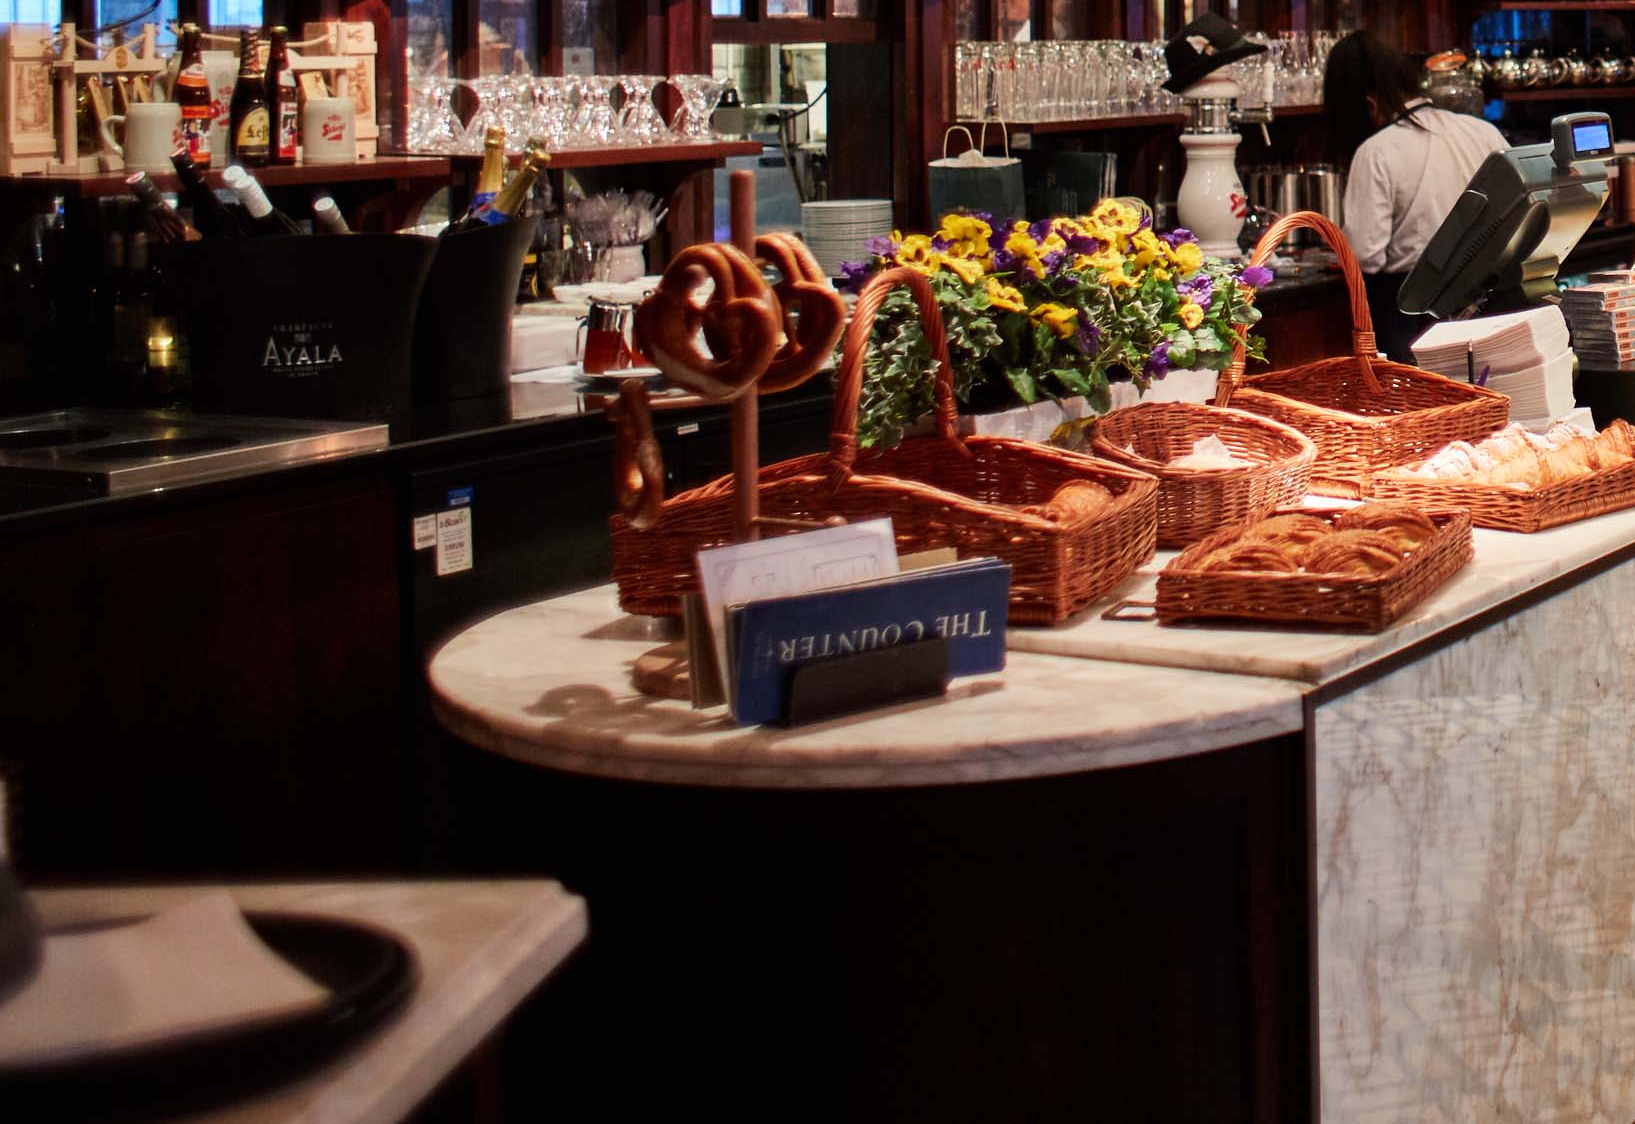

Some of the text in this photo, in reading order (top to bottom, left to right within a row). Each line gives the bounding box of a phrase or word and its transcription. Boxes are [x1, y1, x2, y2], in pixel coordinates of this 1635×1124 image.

[262, 335, 343, 366] AYALA
[936, 610, 991, 638] THE
[780, 620, 924, 662] COUNTER
